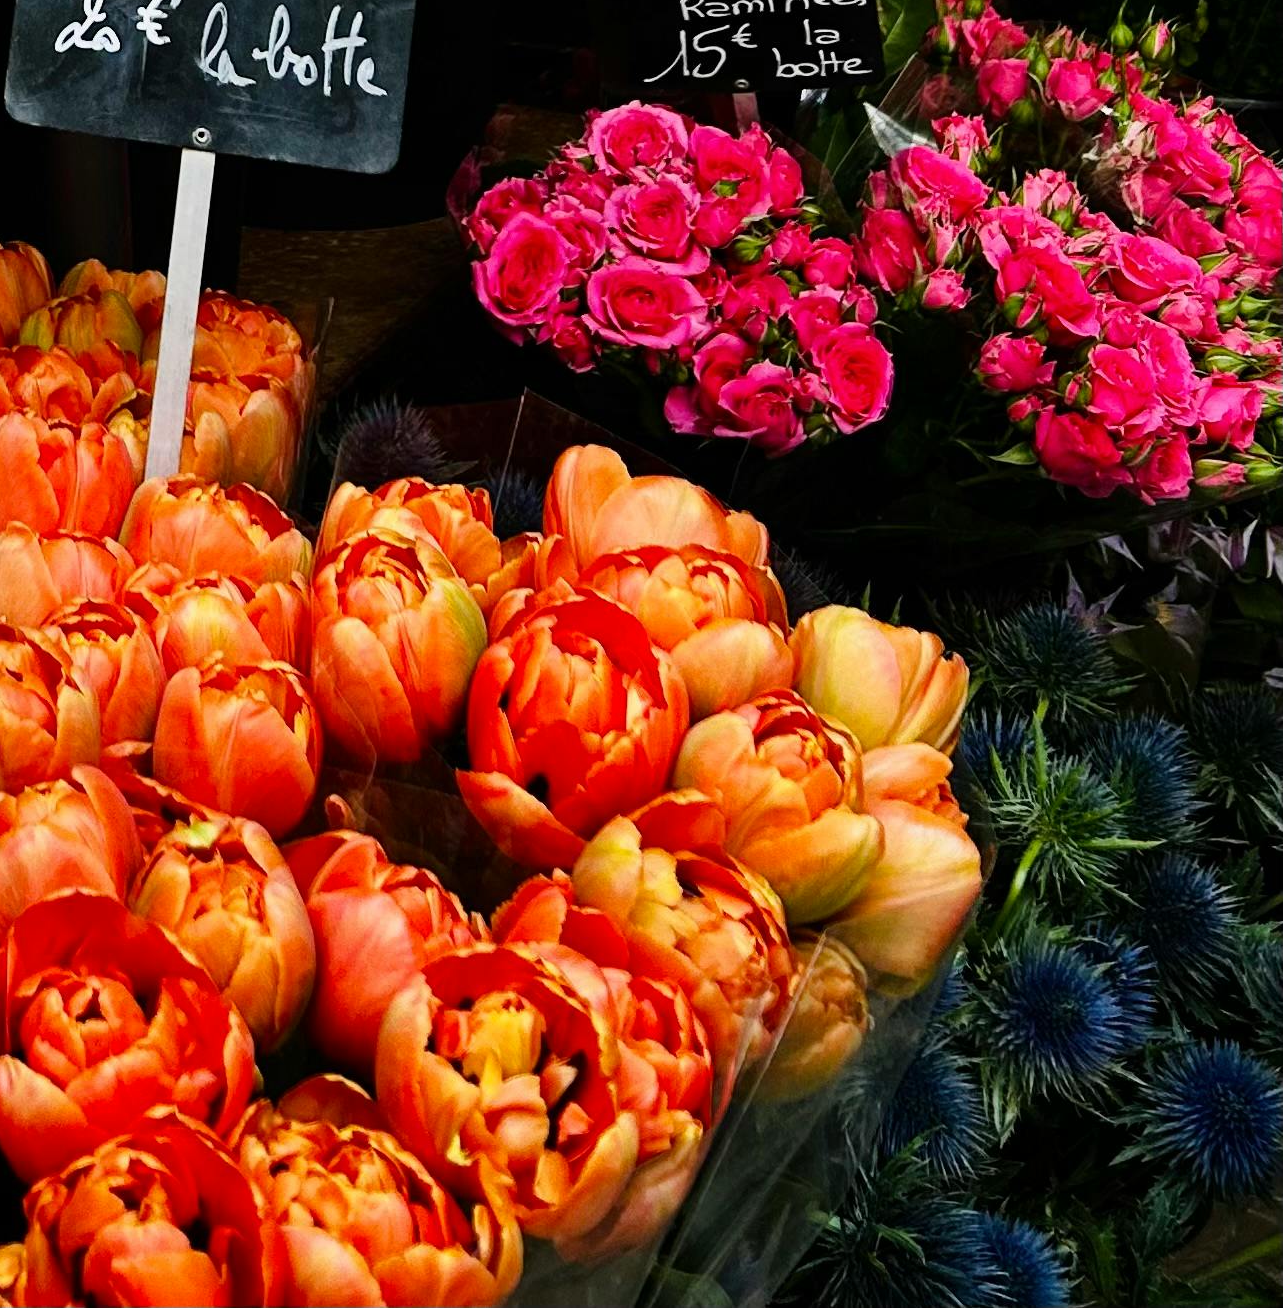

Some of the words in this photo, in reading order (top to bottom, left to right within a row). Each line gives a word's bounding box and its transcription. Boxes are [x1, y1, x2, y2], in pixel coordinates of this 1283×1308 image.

[803, 18, 841, 46] la
[195, 1, 257, 86] la
[252, 3, 389, 97] botte
[771, 47, 873, 77] botte
